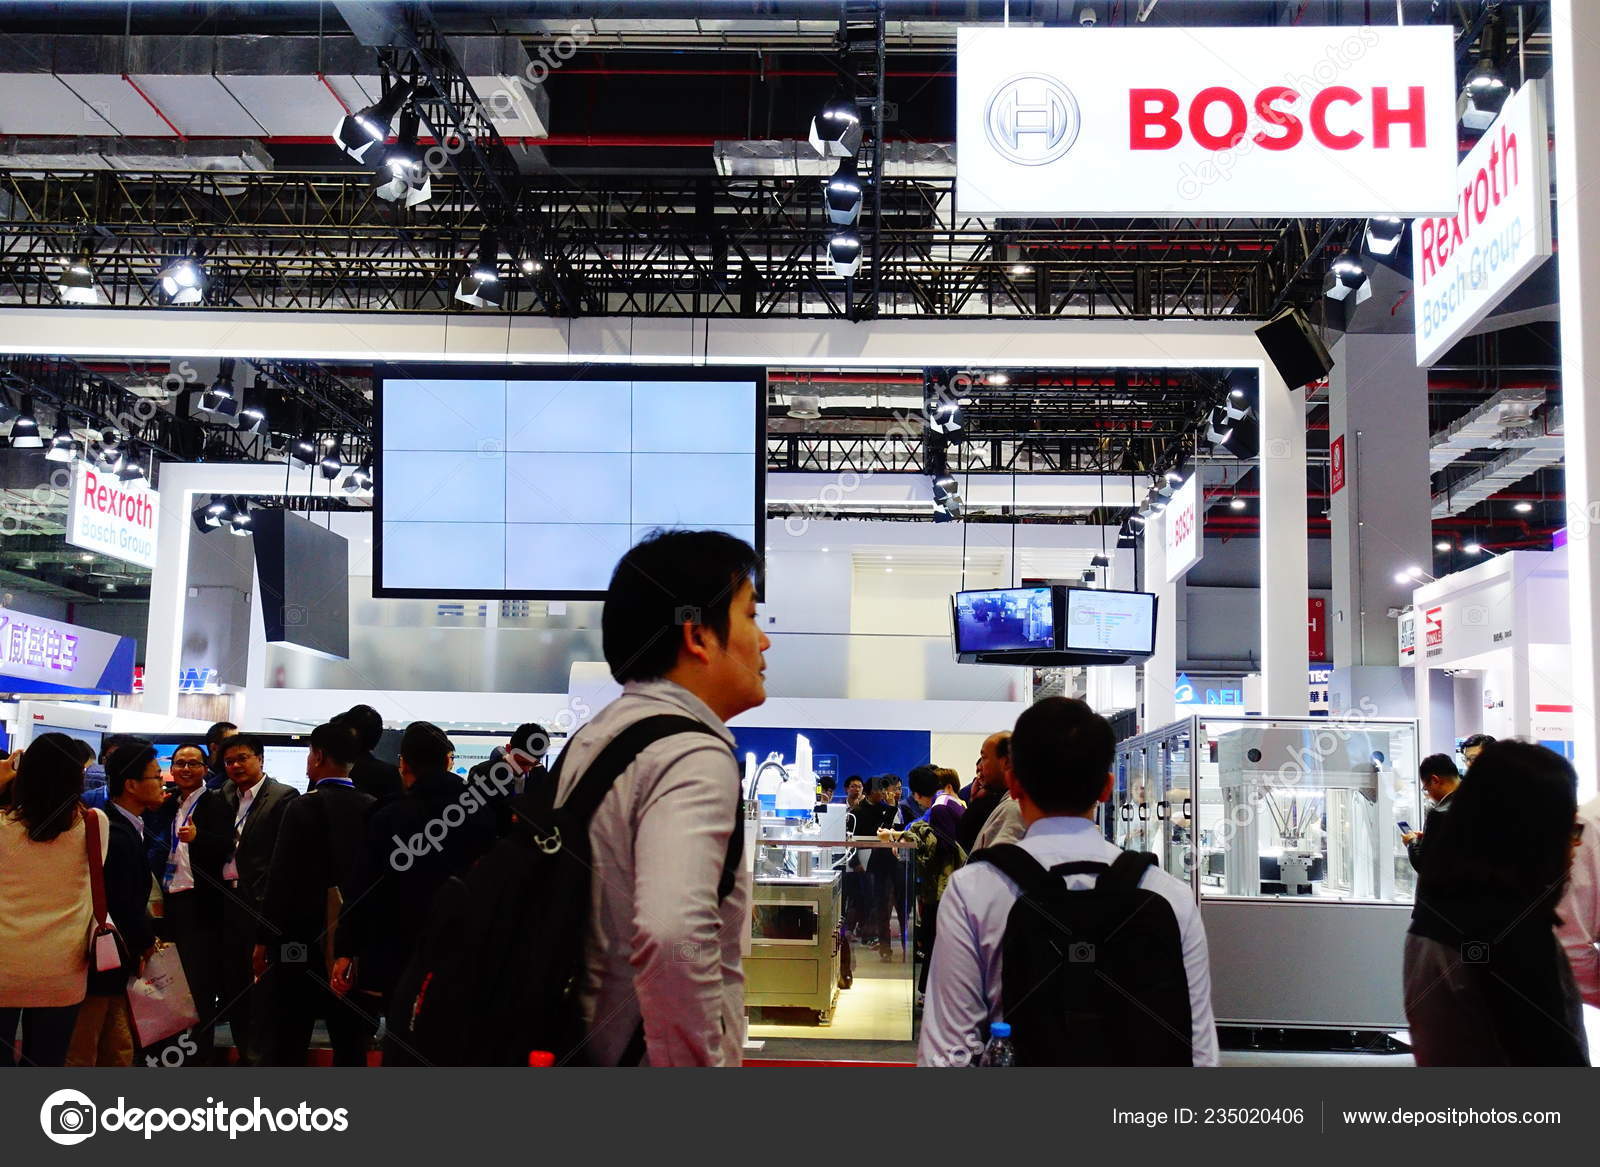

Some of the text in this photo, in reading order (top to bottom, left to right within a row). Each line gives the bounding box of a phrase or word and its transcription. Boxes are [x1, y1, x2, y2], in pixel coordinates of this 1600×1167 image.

[1129, 86, 1427, 152] BOSCH
[1421, 124, 1519, 287] Rexroth
[1423, 214, 1522, 339] Bosch Group
[83, 471, 153, 530] Rexroth
[81, 514, 152, 558] Bosch Group
